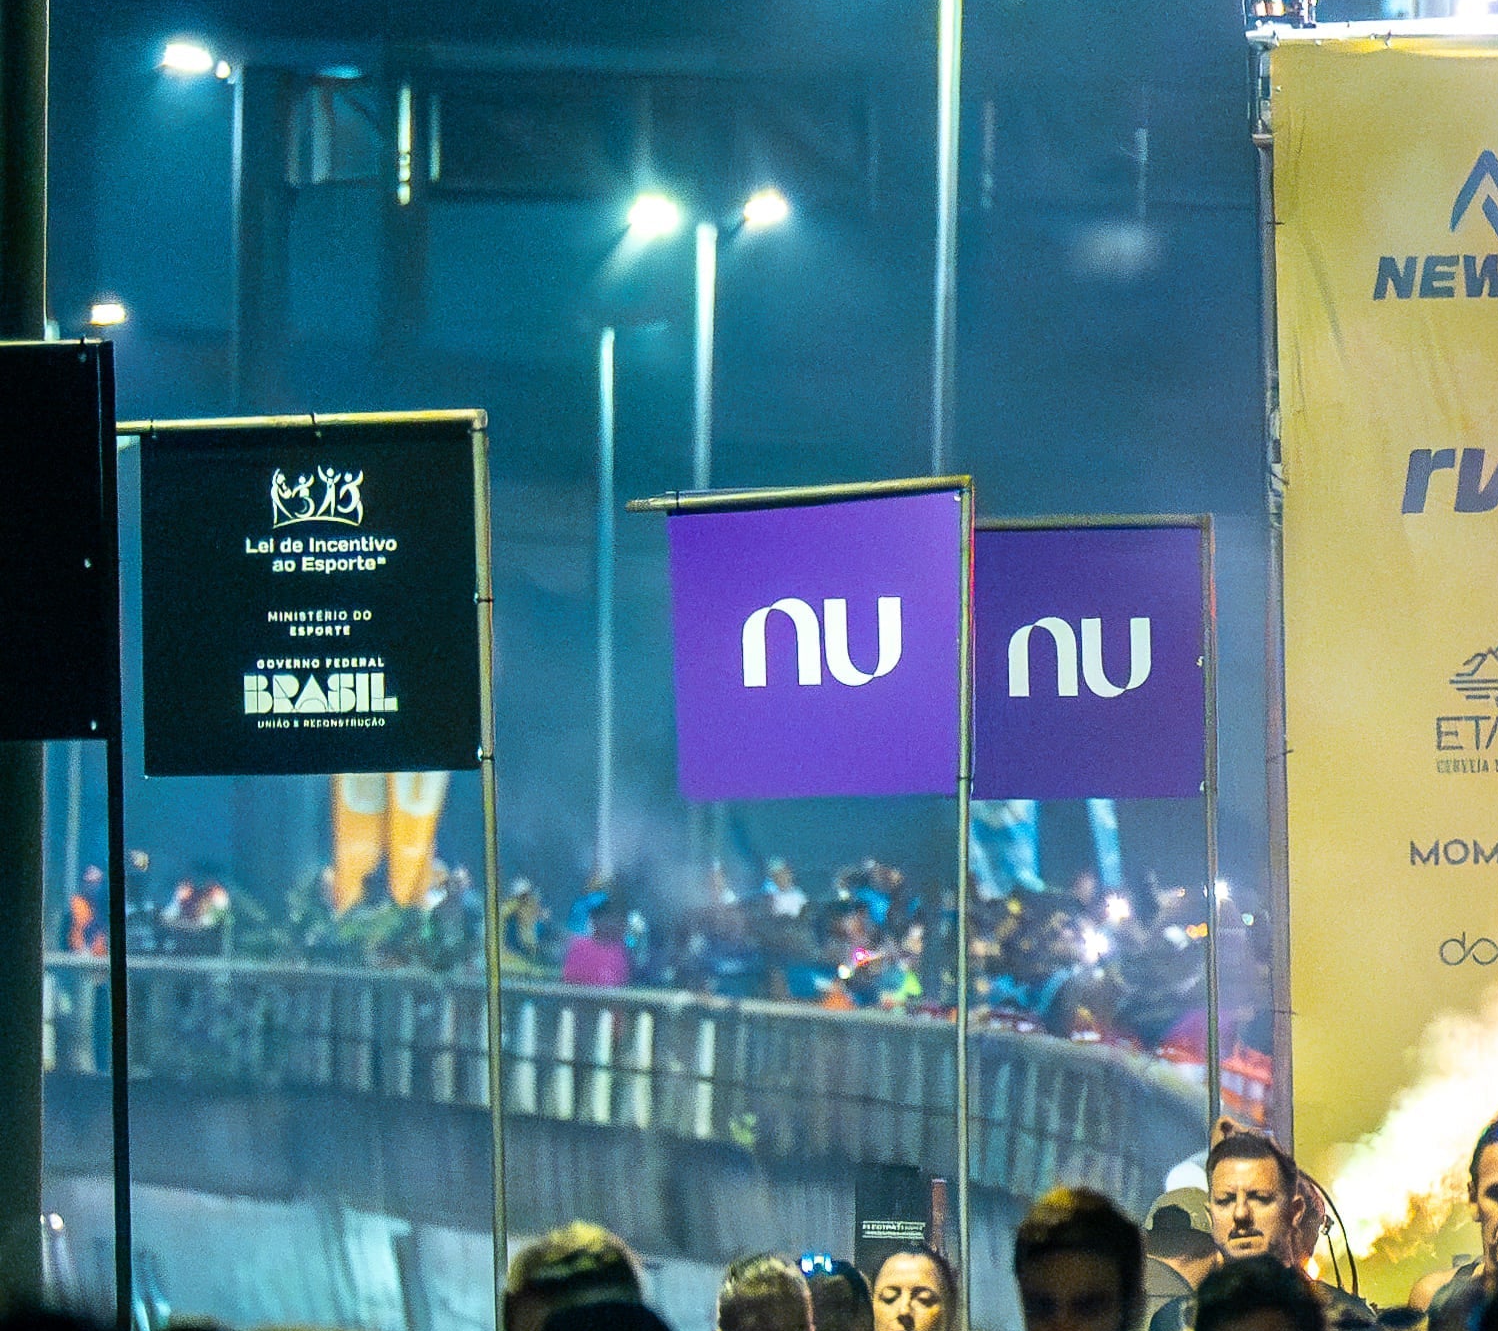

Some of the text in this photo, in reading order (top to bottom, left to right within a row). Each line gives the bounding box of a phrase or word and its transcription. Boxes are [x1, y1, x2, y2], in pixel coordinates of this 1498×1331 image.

[246, 536, 398, 554] Lei de Incentivo
[272, 556, 377, 574] ao Esporte
[268, 610, 372, 622] MINISTÉRIO DO
[290, 625, 351, 636] ESPORTE
[741, 597, 902, 687] nu
[257, 657, 384, 669] GOVERNO FEDERAL
[1008, 616, 1152, 698] nu
[244, 672, 398, 714] BRASIL
